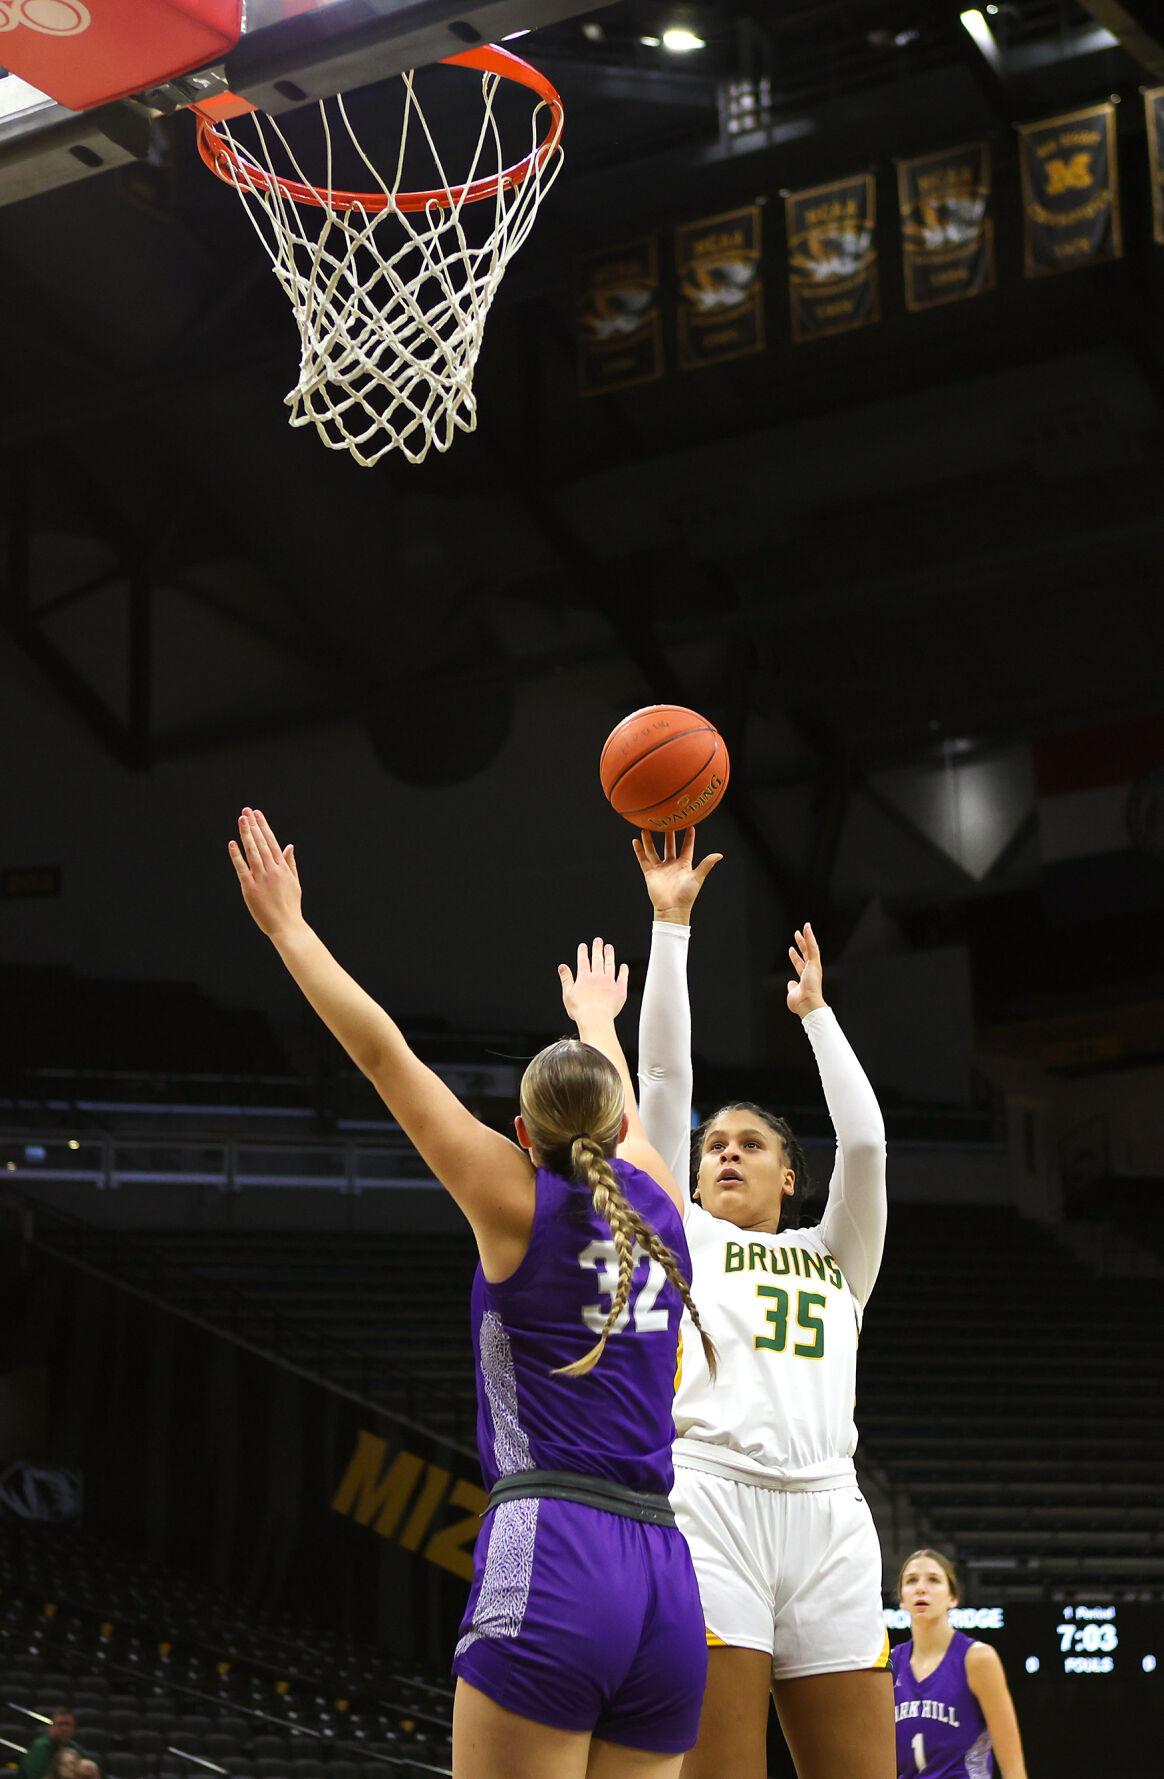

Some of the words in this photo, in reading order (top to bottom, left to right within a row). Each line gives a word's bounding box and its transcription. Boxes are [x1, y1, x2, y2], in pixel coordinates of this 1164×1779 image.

[1044, 152, 1095, 196] M
[648, 774, 724, 829] SPALDING
[577, 1239, 669, 1334] 32
[725, 1241, 842, 1289] BRUINS
[754, 1285, 826, 1359] 35
[331, 1428, 489, 1582] MIZ
[947, 1607, 1005, 1629] RIDGE
[1056, 1623, 1119, 1652] 7:03
[894, 1700, 921, 1723] ARK
[921, 1699, 960, 1728] HILL
[911, 1732, 928, 1774] 1
